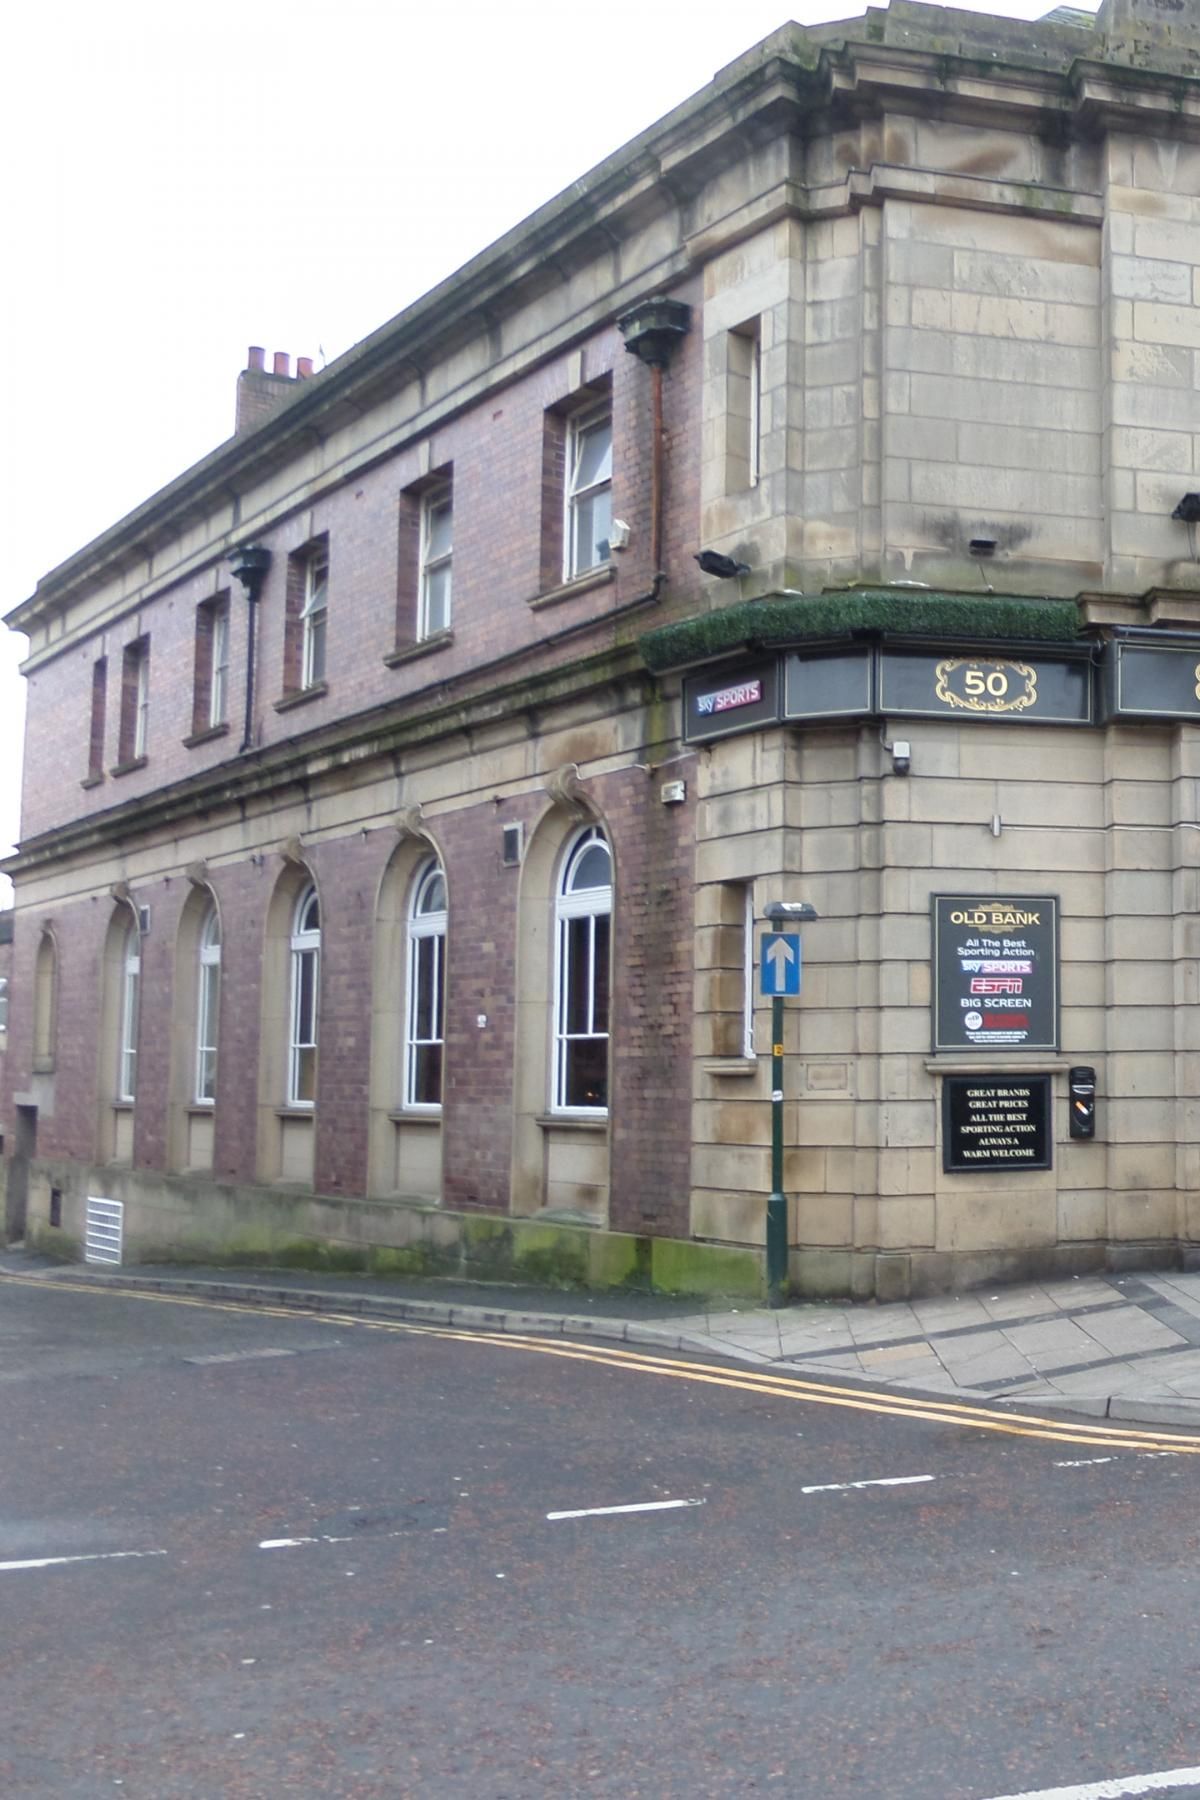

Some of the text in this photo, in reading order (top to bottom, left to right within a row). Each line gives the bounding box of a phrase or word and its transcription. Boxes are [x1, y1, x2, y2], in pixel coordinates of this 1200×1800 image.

[964, 670, 1008, 696] 50
[716, 684, 760, 709] SPORTS
[950, 911, 1041, 925] OLD BANK
[966, 939, 1026, 948] All The Best
[957, 947, 1035, 957] Sporting Action
[982, 961, 1032, 973] SPORTS
[970, 978, 1023, 994] ESPN
[960, 998, 1032, 1008] BIG SCREEN
[966, 1088, 1031, 1097] GREAT BRANDS
[968, 1100, 1029, 1109] GREAT PRICES
[970, 1113, 1028, 1122] ALL THE BEST
[960, 1124, 1037, 1134] SPORTING ACTION
[978, 1137, 1020, 1146] ALWAYS A
[962, 1148, 1036, 1158] WARM WELCOME
